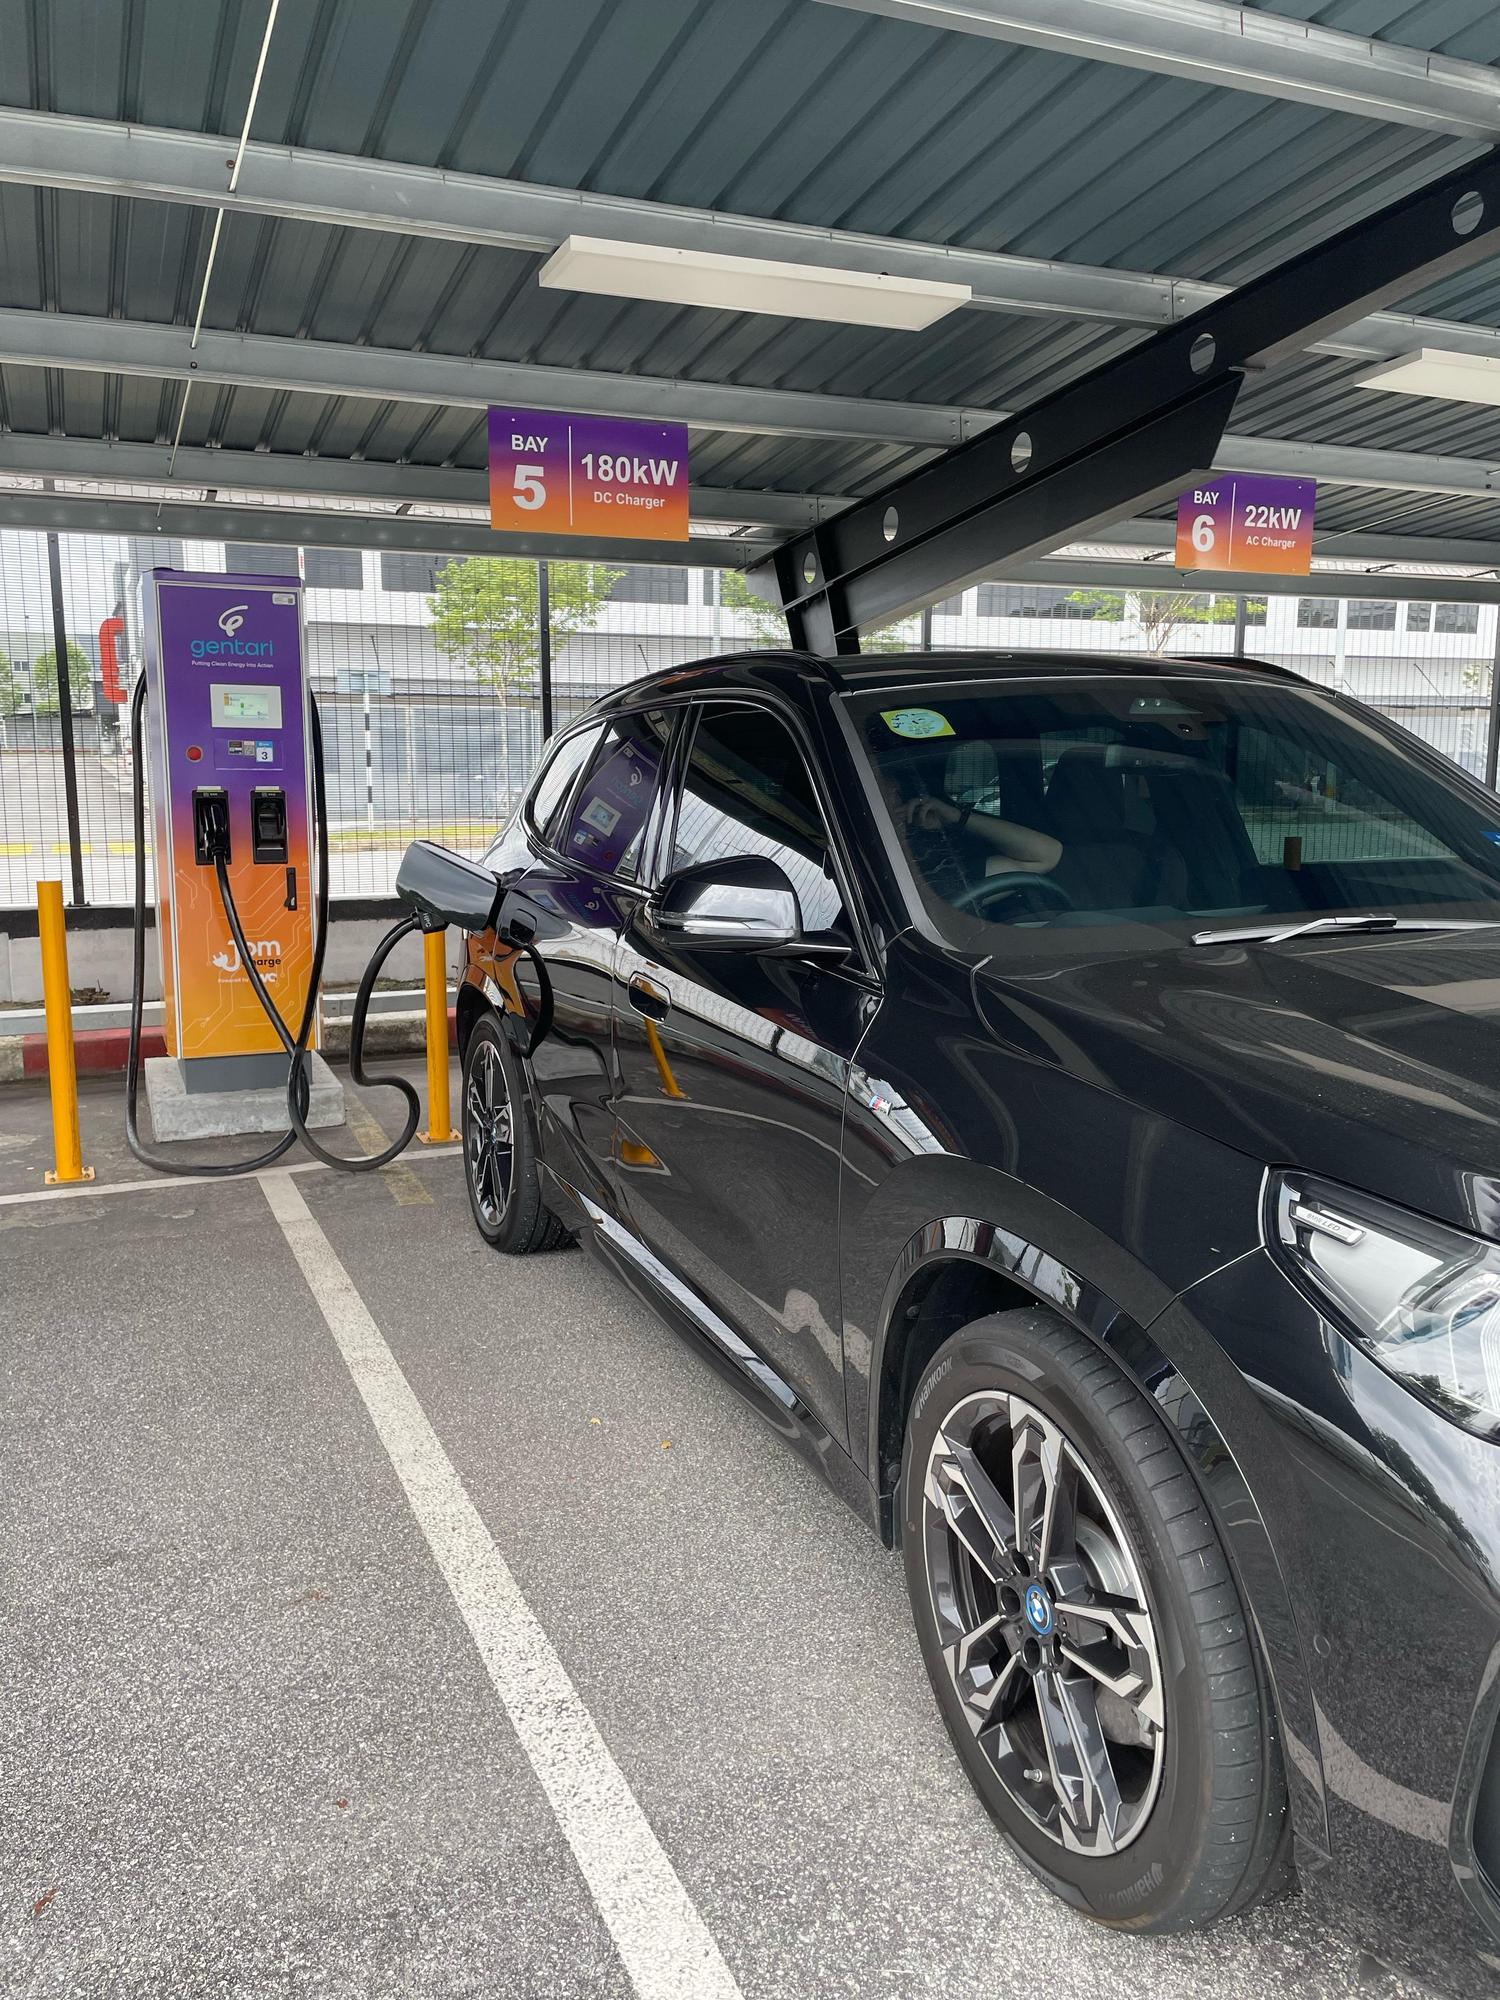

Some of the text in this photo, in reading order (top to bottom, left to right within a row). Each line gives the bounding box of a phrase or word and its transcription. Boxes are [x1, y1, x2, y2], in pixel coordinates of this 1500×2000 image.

[511, 434, 548, 453] BAY
[581, 453, 679, 486] 180kW
[512, 464, 547, 511] 5
[593, 491, 666, 510] DC Charger
[1193, 490, 1219, 505] BAY
[1244, 505, 1301, 530] 22kW
[1191, 514, 1215, 552] 6
[1246, 535, 1296, 550] AC Charger
[191, 639, 274, 658] gentari
[261, 751, 268, 761] 3
[1322, 1221, 1341, 1231] LED
